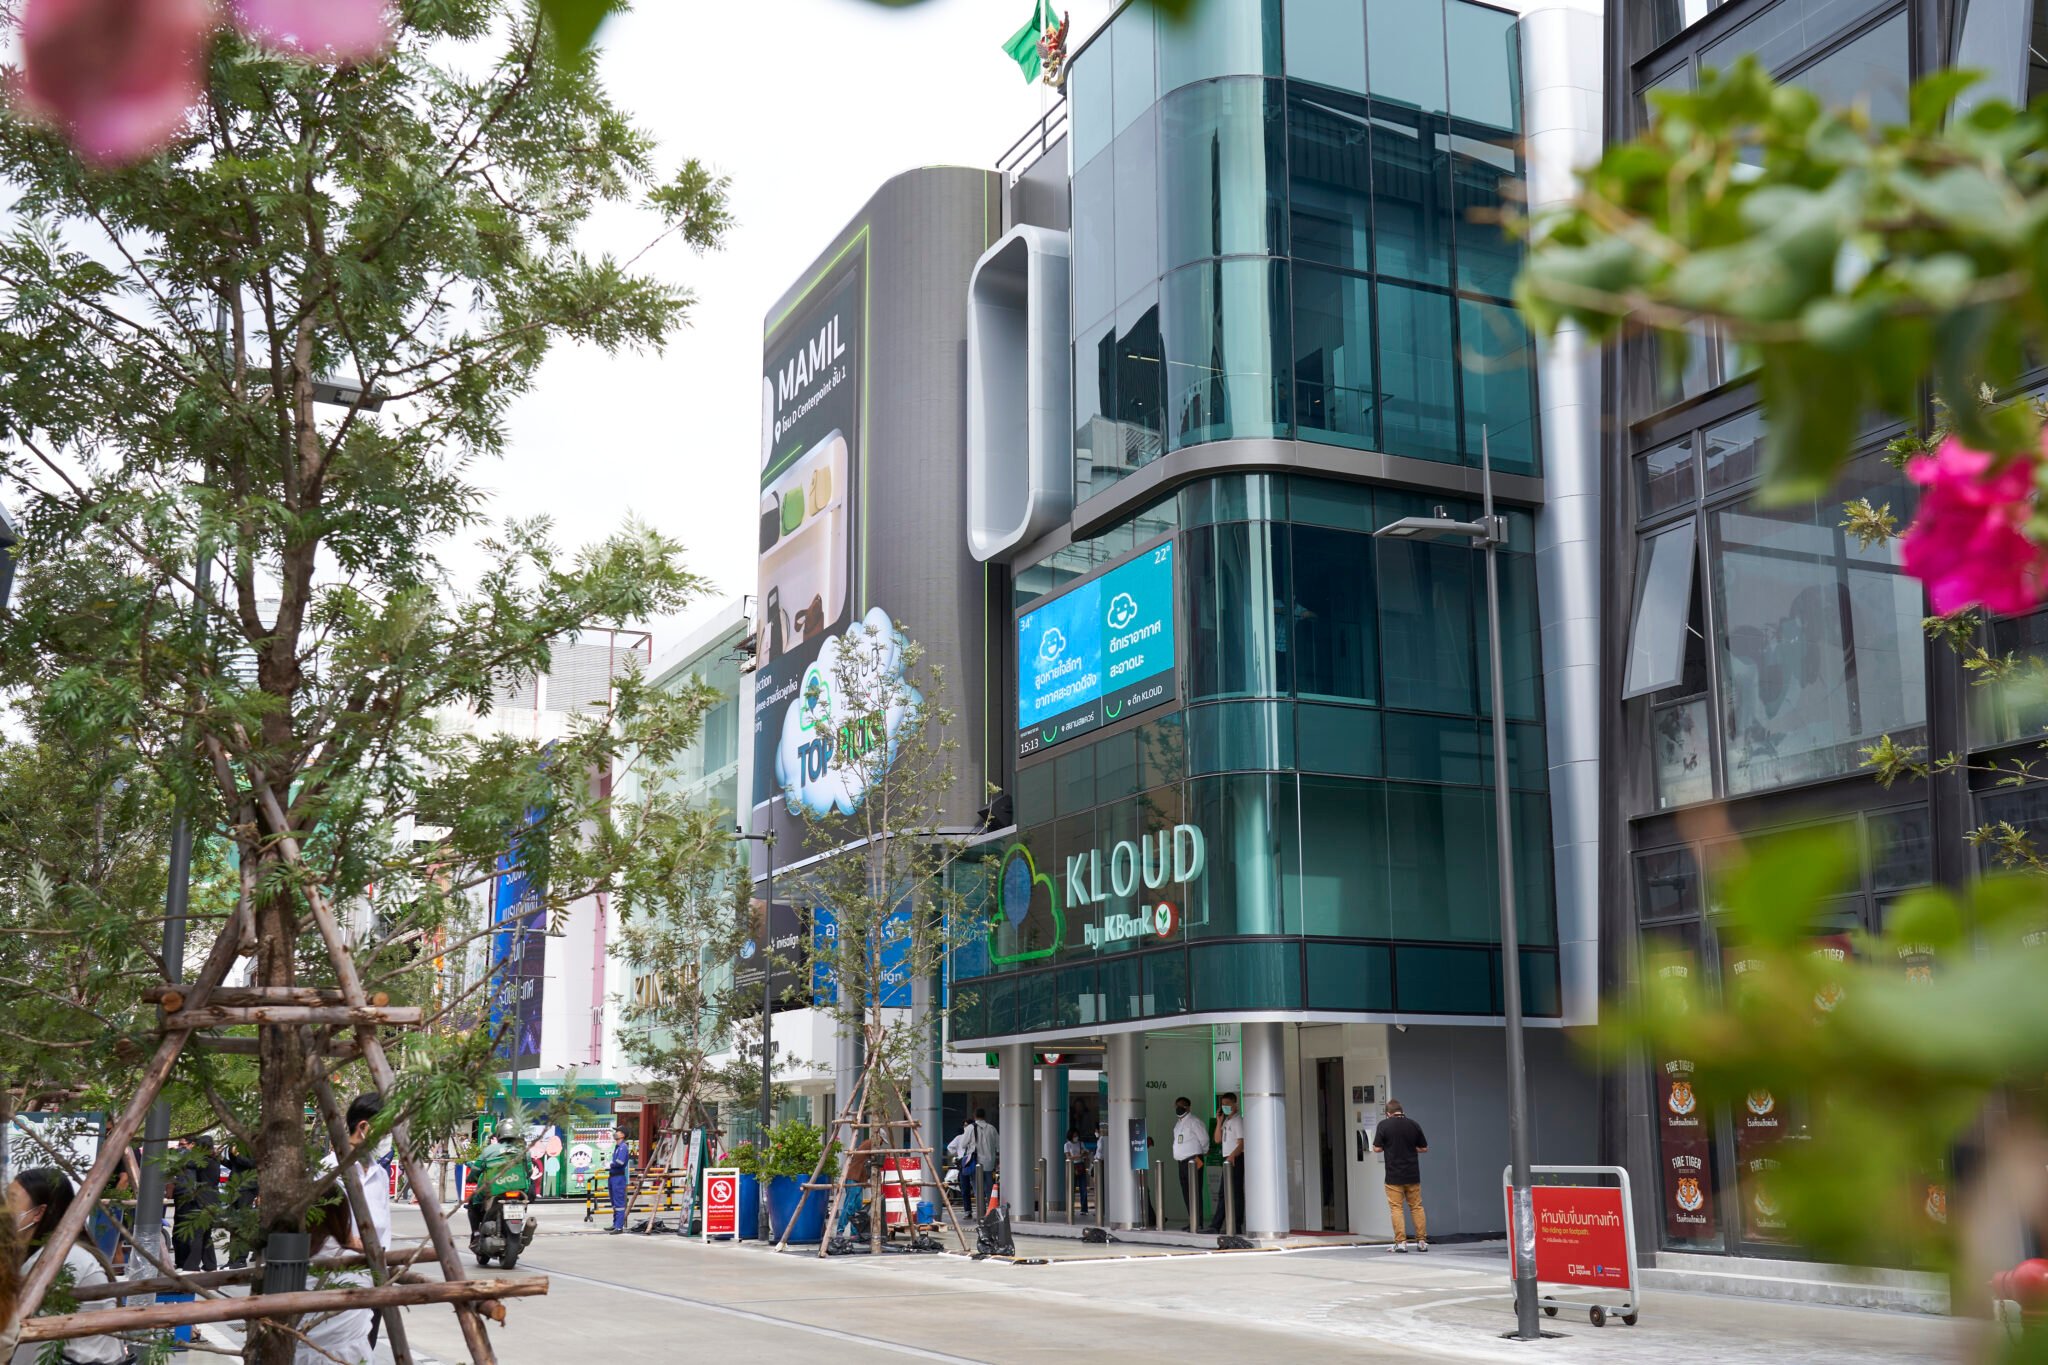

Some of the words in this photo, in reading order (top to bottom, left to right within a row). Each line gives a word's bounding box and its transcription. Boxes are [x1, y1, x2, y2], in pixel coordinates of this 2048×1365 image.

[779, 314, 845, 411] MAMIL
[792, 410, 797, 424] D
[798, 379, 831, 418] Centerpoint
[842, 365, 846, 379] 1
[1109, 620, 1162, 654] ตึกเราอากาศ
[1109, 653, 1144, 678] สะอาดนะ
[1141, 685, 1163, 701] KLOUD
[1020, 738, 1039, 754] 15:13
[798, 736, 834, 788] TOP
[1066, 824, 1204, 908] KLOUD
[1084, 923, 1104, 949] by
[1104, 904, 1157, 942] KBank
[1823, 948, 1845, 963] TIGER
[1671, 965, 1688, 978] TIGER
[1217, 1051, 1232, 1062] ATM
[1665, 1061, 1678, 1074] FIRE
[1679, 1060, 1695, 1073] TIGER
[1145, 1080, 1168, 1089] 430/6
[1672, 1156, 1685, 1170] FIRE
[1686, 1155, 1702, 1170] TIGER
[495, 1173, 520, 1185] Grab
[1541, 1206, 1620, 1227] ห้ามขับขี่บนทางเท้า
